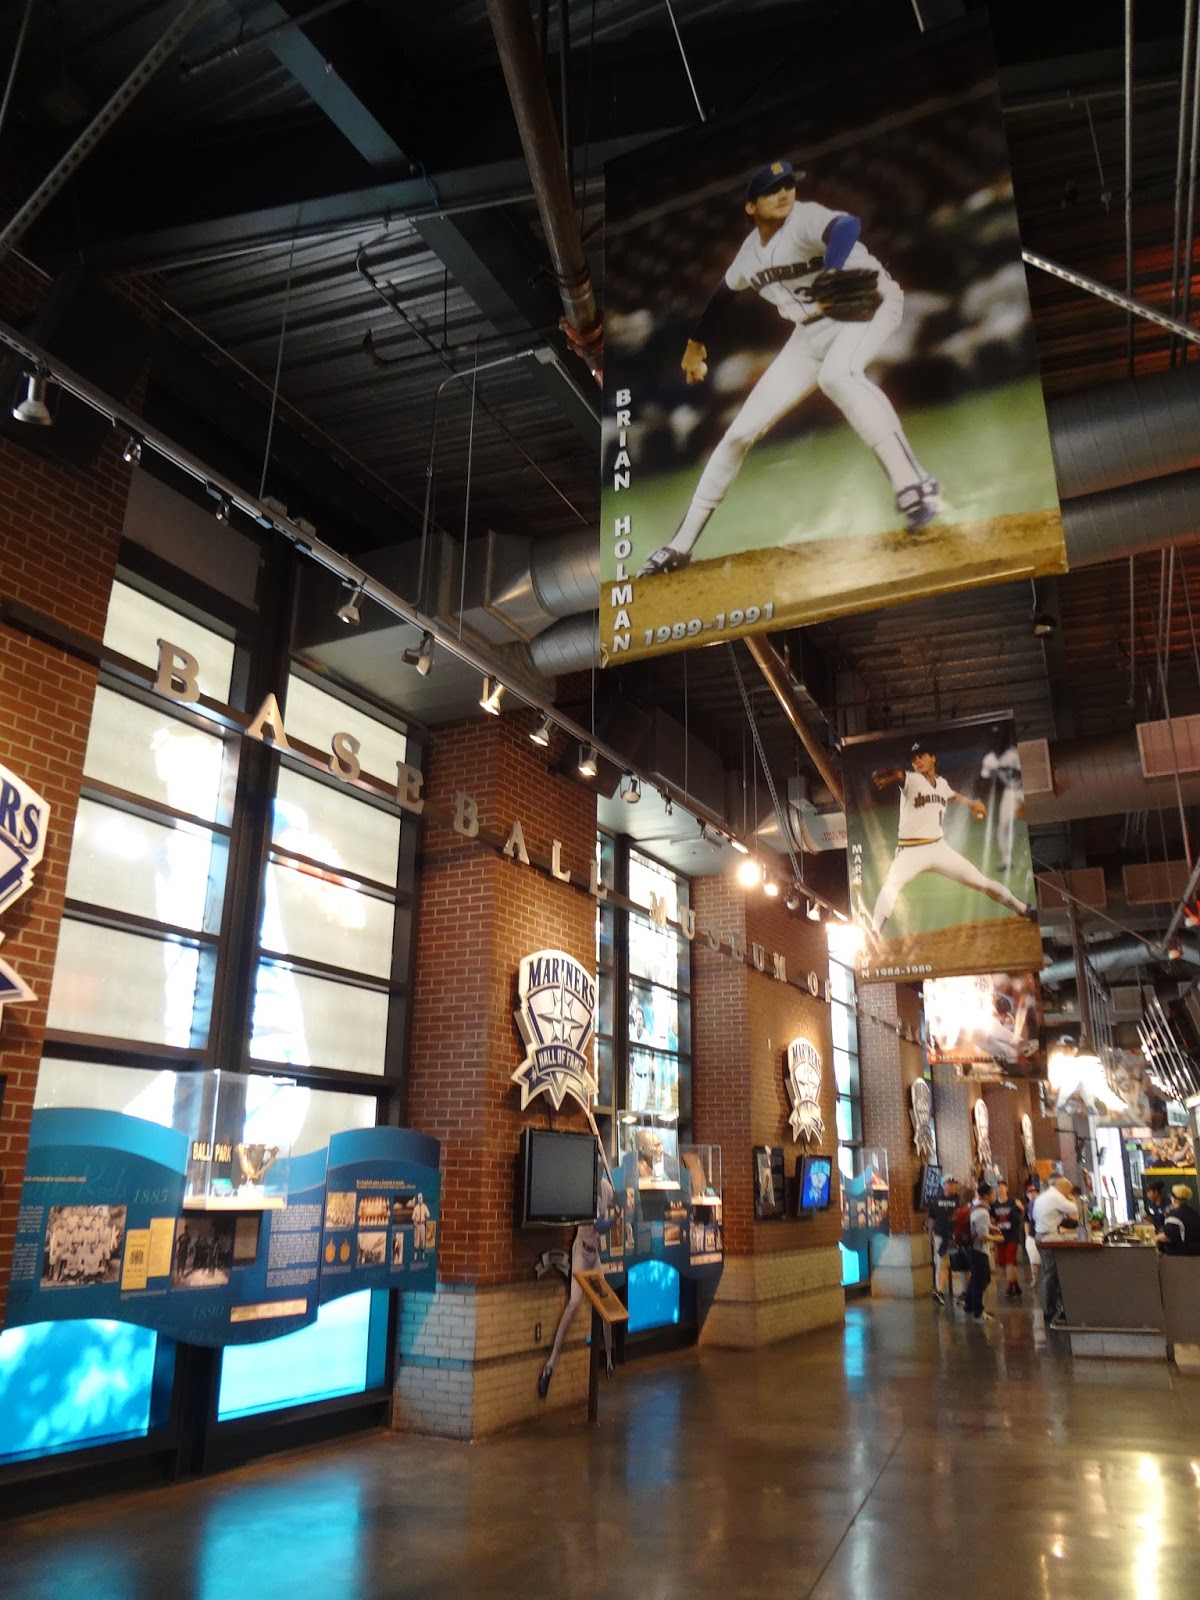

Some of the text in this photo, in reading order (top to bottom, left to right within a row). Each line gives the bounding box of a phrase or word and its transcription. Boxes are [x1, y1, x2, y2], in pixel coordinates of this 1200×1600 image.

[614, 388, 633, 492] BRIAN
[611, 515, 634, 654] HOLMAN
[643, 601, 775, 646] 1989-1991
[851, 843, 864, 885] MARK
[528, 955, 596, 1011] MARINERS
[538, 1048, 584, 1075] HALL OF FAME
[192, 1142, 233, 1162] BALL PARK
